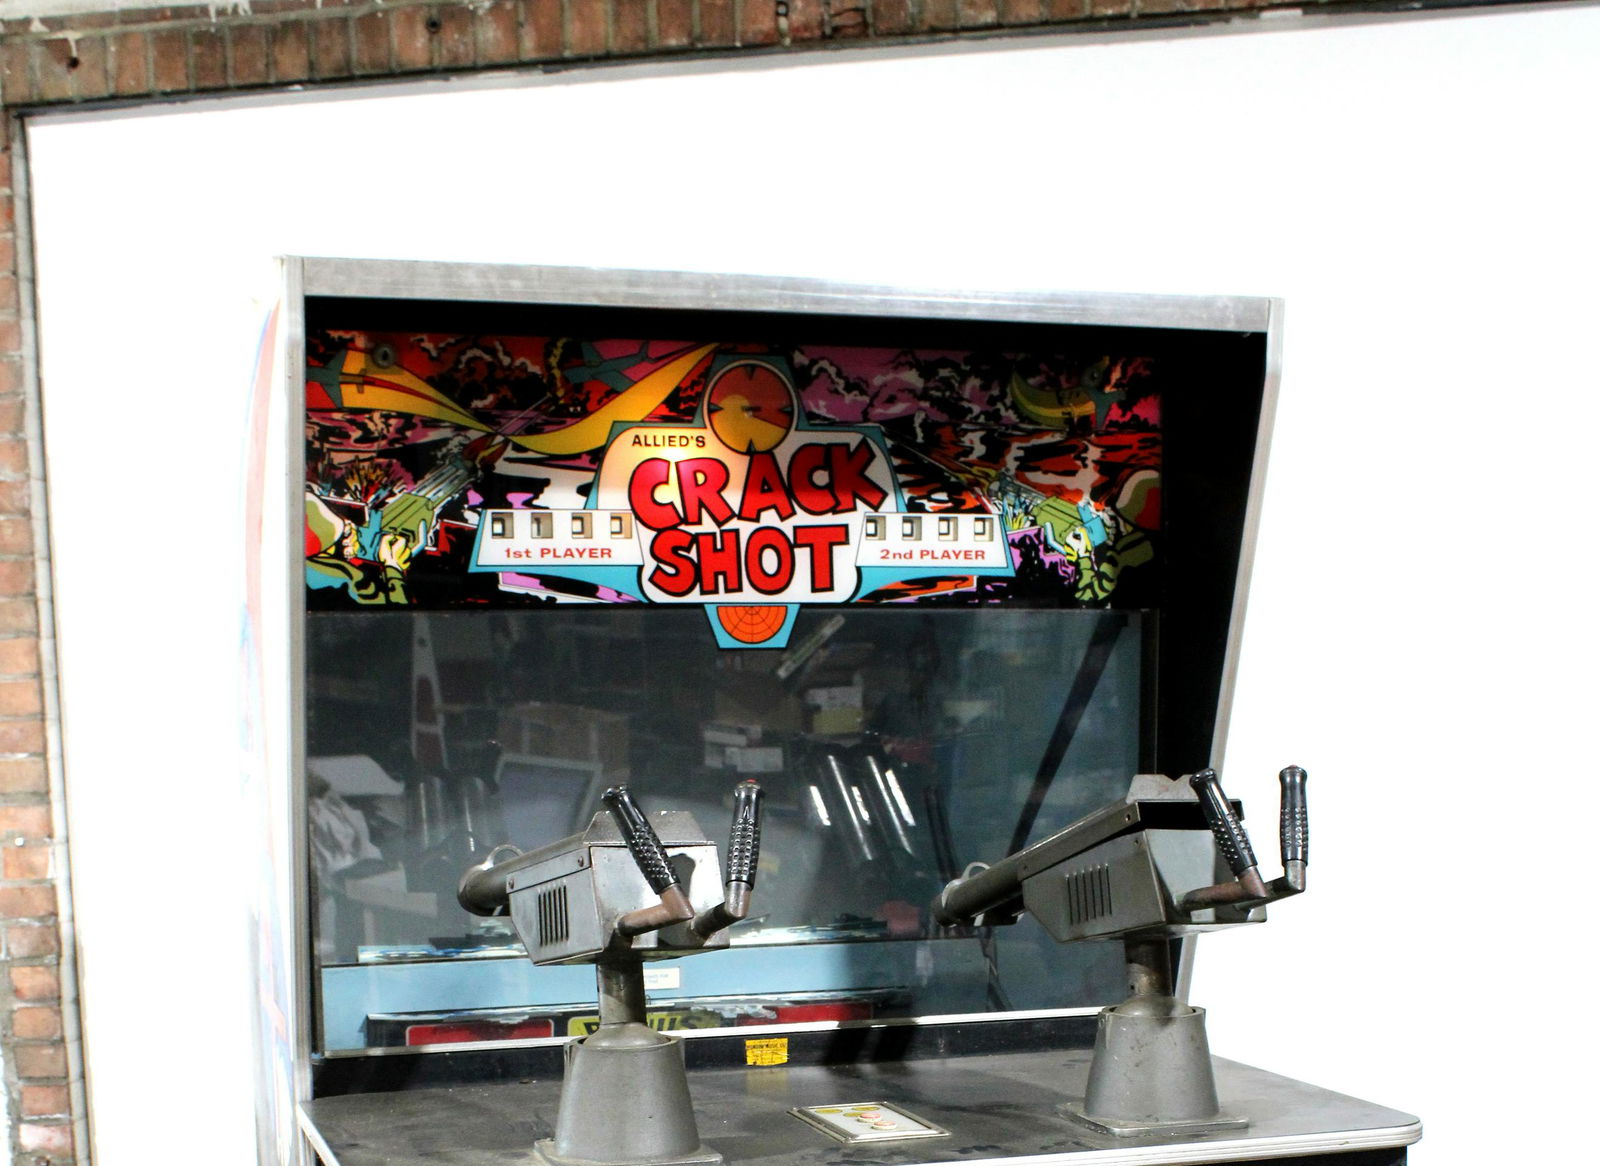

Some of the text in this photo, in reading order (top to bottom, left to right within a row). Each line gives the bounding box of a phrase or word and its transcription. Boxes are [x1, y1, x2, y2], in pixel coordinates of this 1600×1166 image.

[632, 435, 706, 448] ALLIED'S
[628, 436, 889, 531] CRACK
[505, 547, 612, 559] 1st PLAYER
[880, 549, 986, 560] 2nd PLAYER
[648, 523, 850, 598] SHOT
